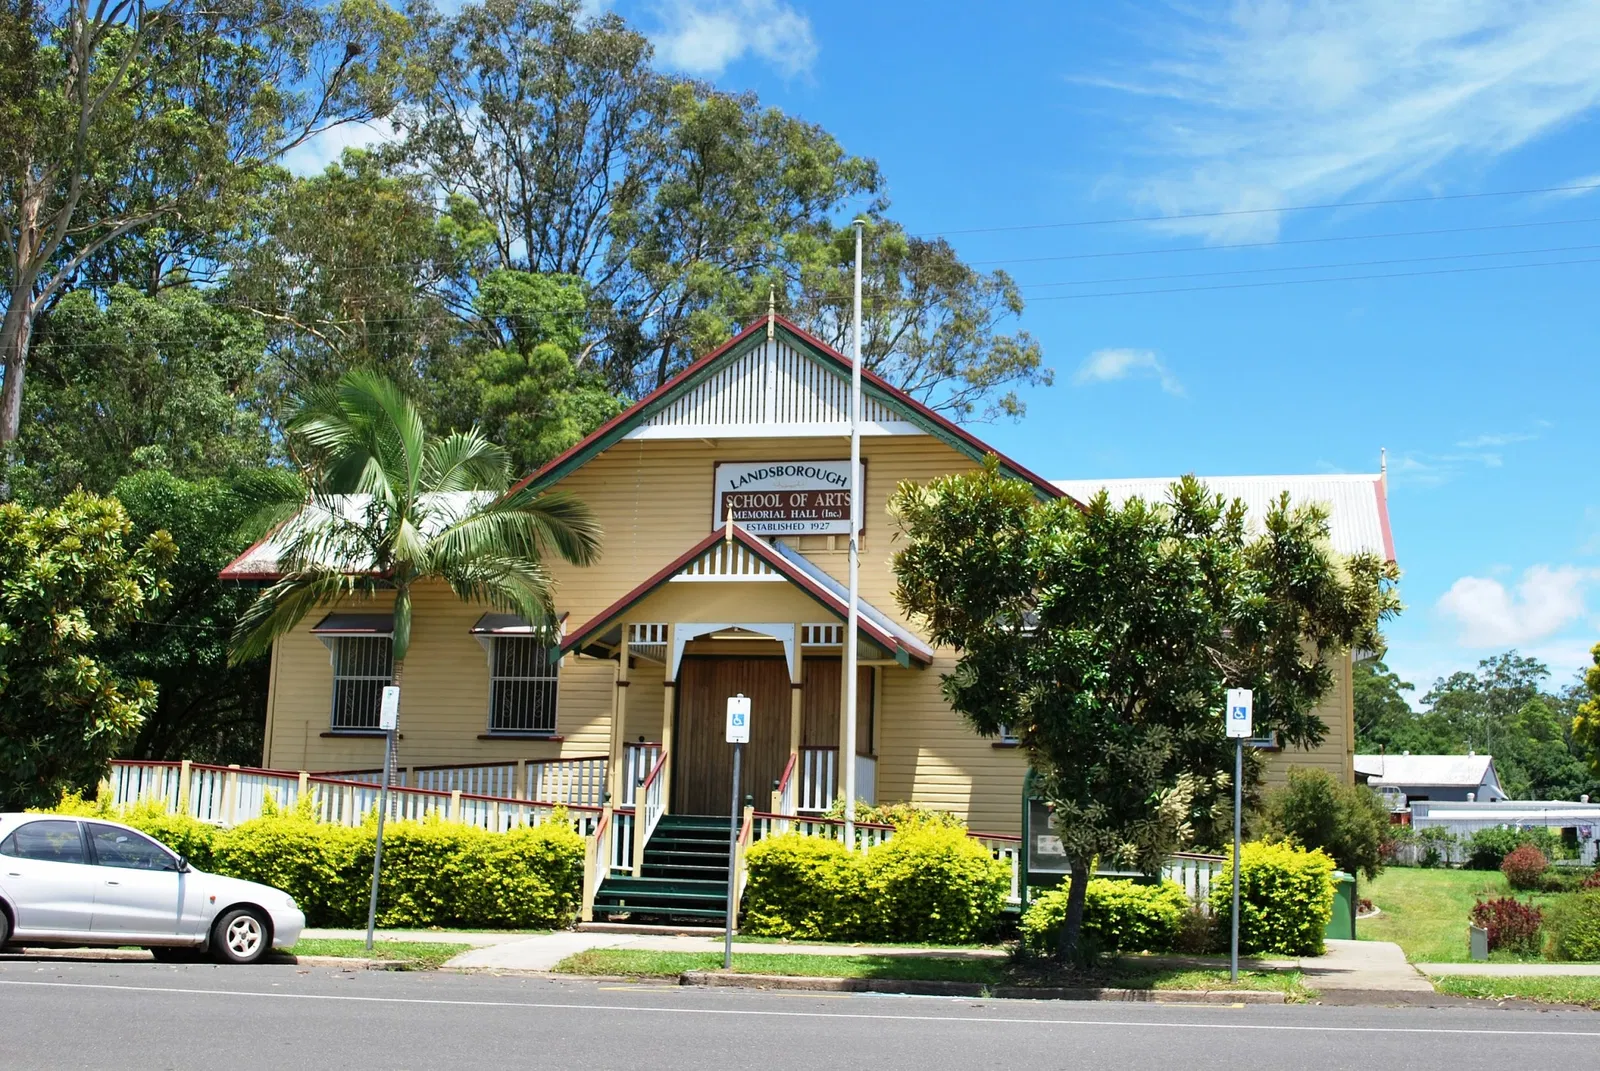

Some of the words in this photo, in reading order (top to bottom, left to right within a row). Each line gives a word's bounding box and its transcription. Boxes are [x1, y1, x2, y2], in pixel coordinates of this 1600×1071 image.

[730, 465, 848, 490] LANDSBOROUGH
[726, 493, 783, 508] SCHOOL
[789, 493, 809, 508] OF
[814, 492, 851, 507] ARTS
[732, 510, 786, 519] MEMORIAL
[791, 509, 818, 518] HALL
[821, 509, 842, 519] (Inc.)
[746, 523, 805, 531] ESTABLISHED
[810, 522, 830, 530] 1927
